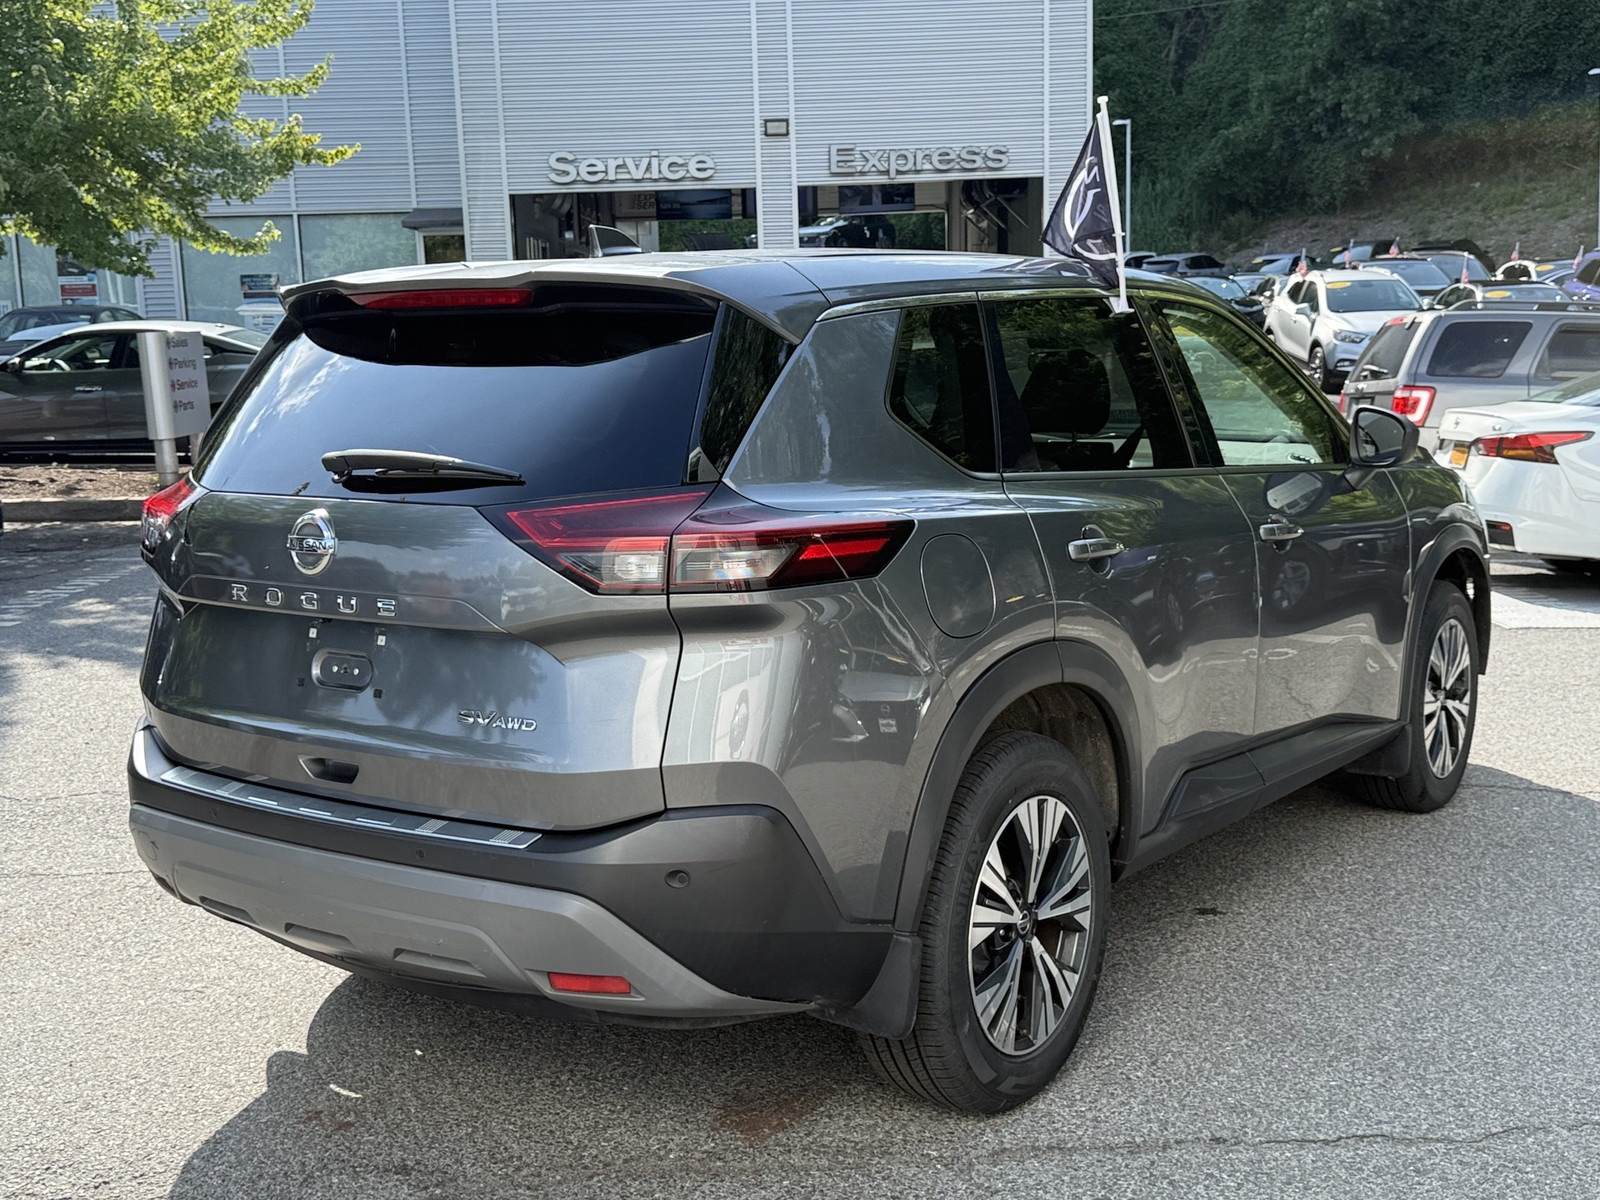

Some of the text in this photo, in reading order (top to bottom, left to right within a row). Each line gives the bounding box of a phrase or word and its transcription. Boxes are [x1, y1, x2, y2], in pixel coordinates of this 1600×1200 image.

[548, 150, 716, 184] Service
[829, 144, 1010, 179] Express
[637, 193, 655, 202] EXP
[171, 337, 188, 348] Sales
[174, 357, 197, 370] Parking
[176, 379, 198, 390] Service
[179, 400, 195, 412] Parts
[290, 539, 327, 550] NISSAN
[231, 583, 397, 617] ROGUE
[458, 709, 537, 731] SV AWD
